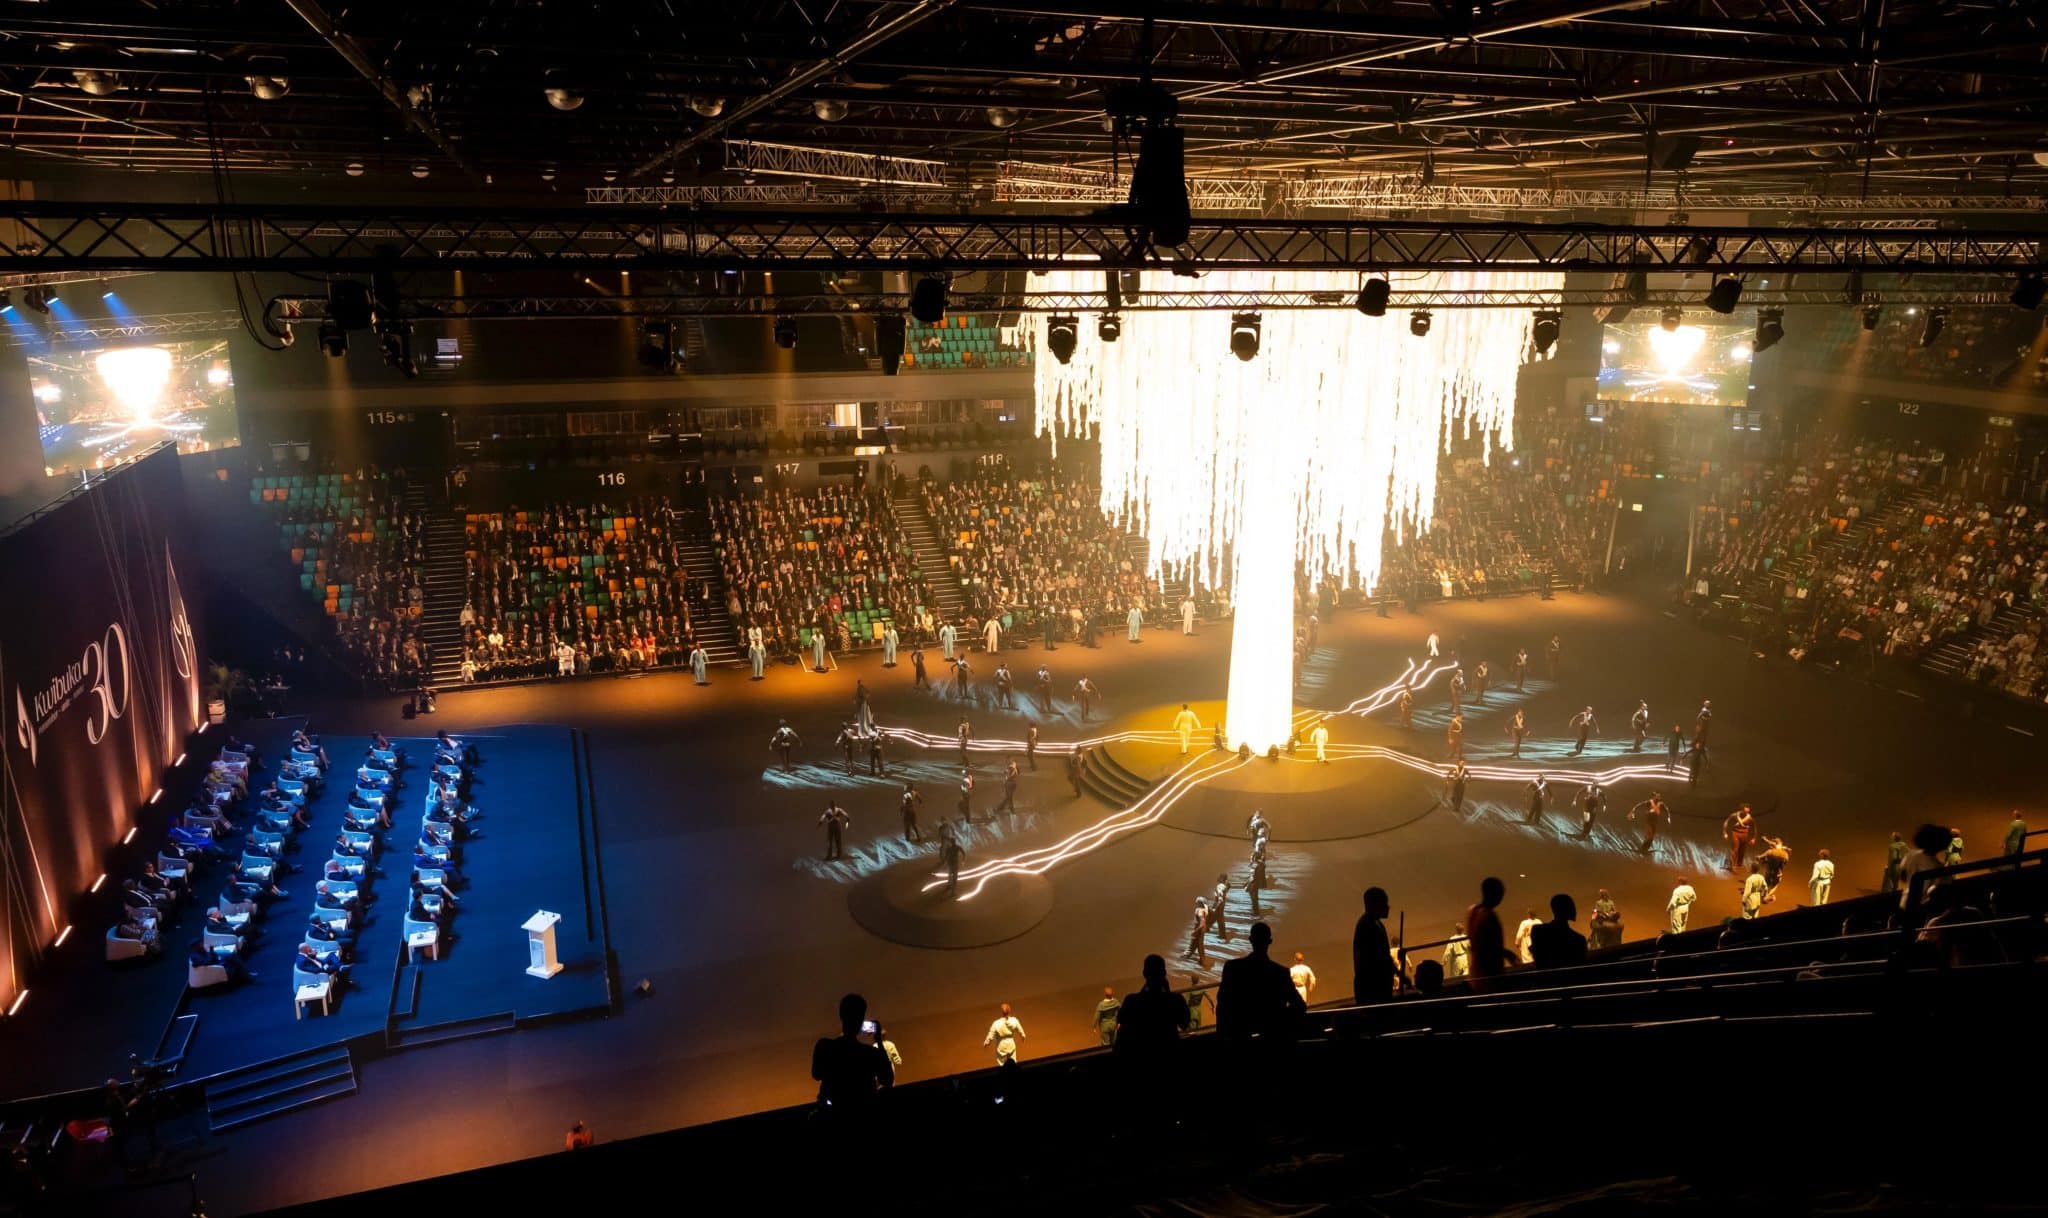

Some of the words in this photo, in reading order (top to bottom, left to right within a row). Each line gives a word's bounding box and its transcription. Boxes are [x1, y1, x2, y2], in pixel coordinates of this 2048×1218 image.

[1898, 402, 1920, 416] 122
[367, 411, 396, 425] 115
[775, 462, 801, 476] 117
[598, 472, 626, 486] 116
[34, 661, 82, 722] Kwibuka
[82, 622, 129, 745] 30
